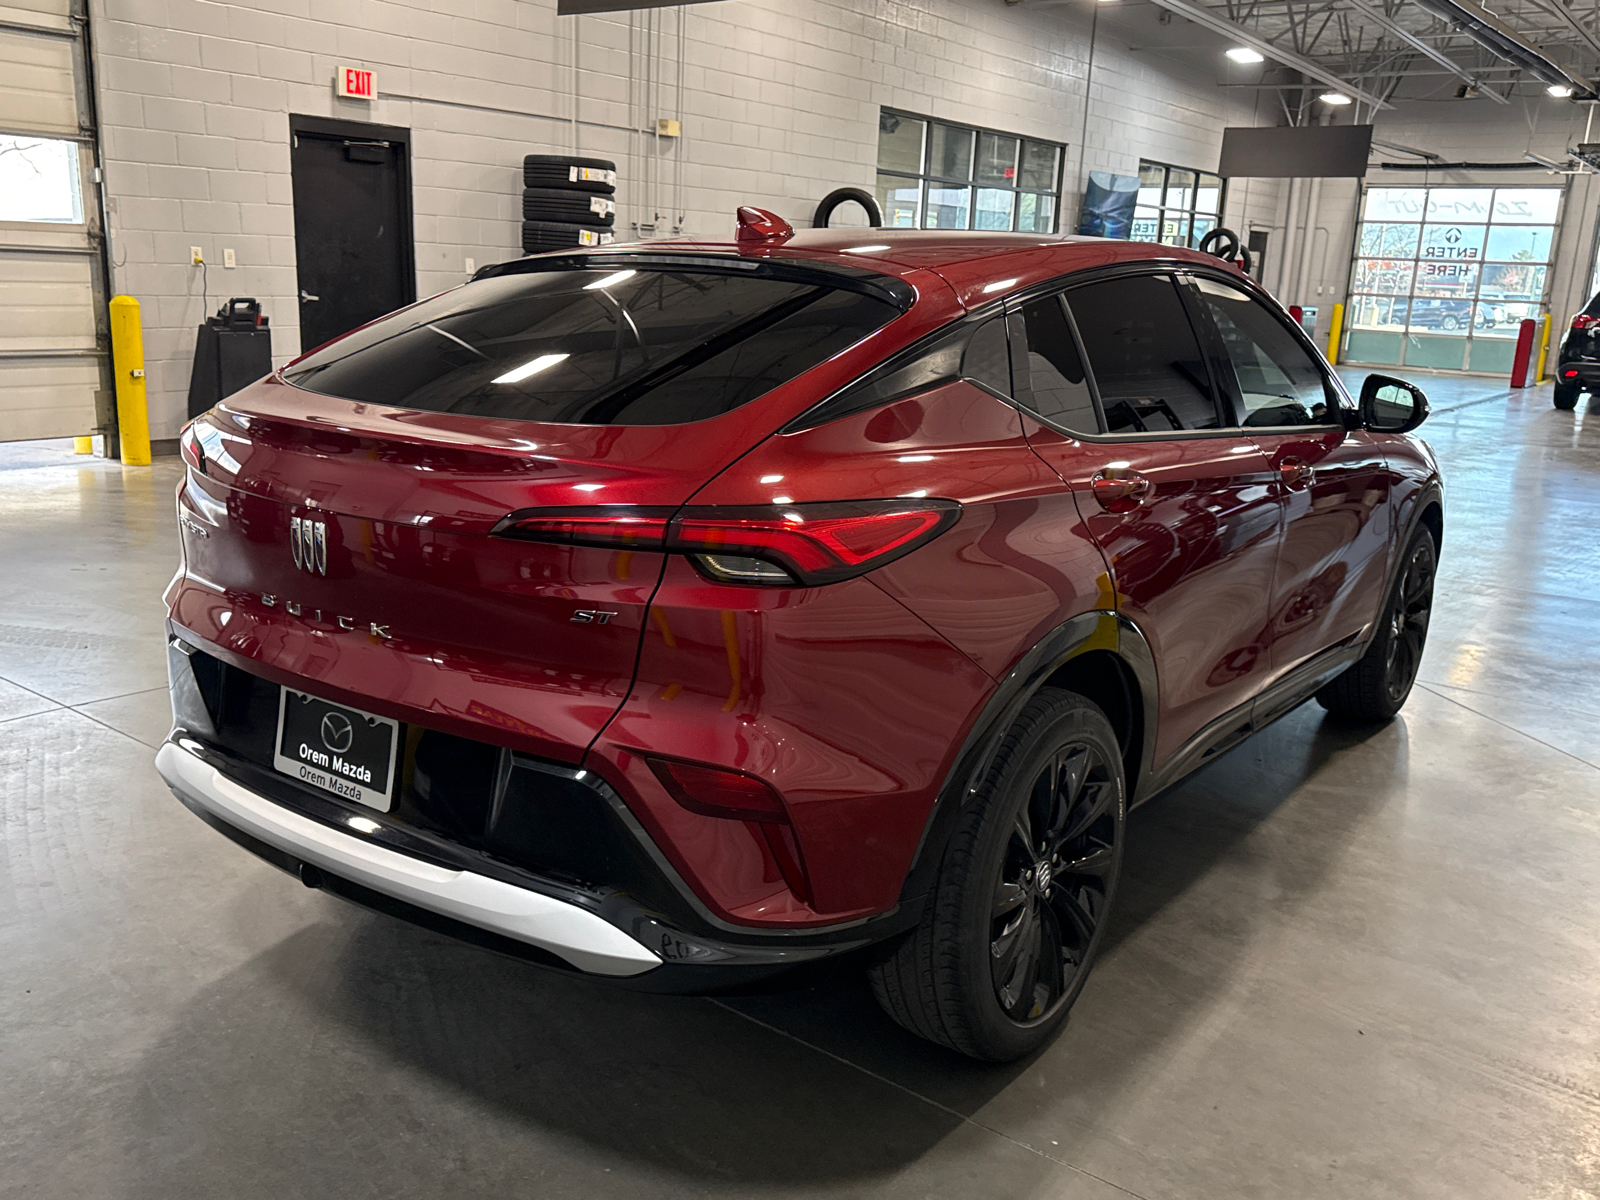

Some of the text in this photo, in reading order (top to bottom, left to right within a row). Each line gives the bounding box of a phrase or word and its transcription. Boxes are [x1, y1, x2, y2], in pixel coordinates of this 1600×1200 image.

[346, 69, 372, 96] EXIT
[261, 592, 392, 639] BUICK
[569, 609, 618, 625] ST
[299, 743, 371, 783] Orem Mazda
[299, 765, 362, 801] Orem Mazda
